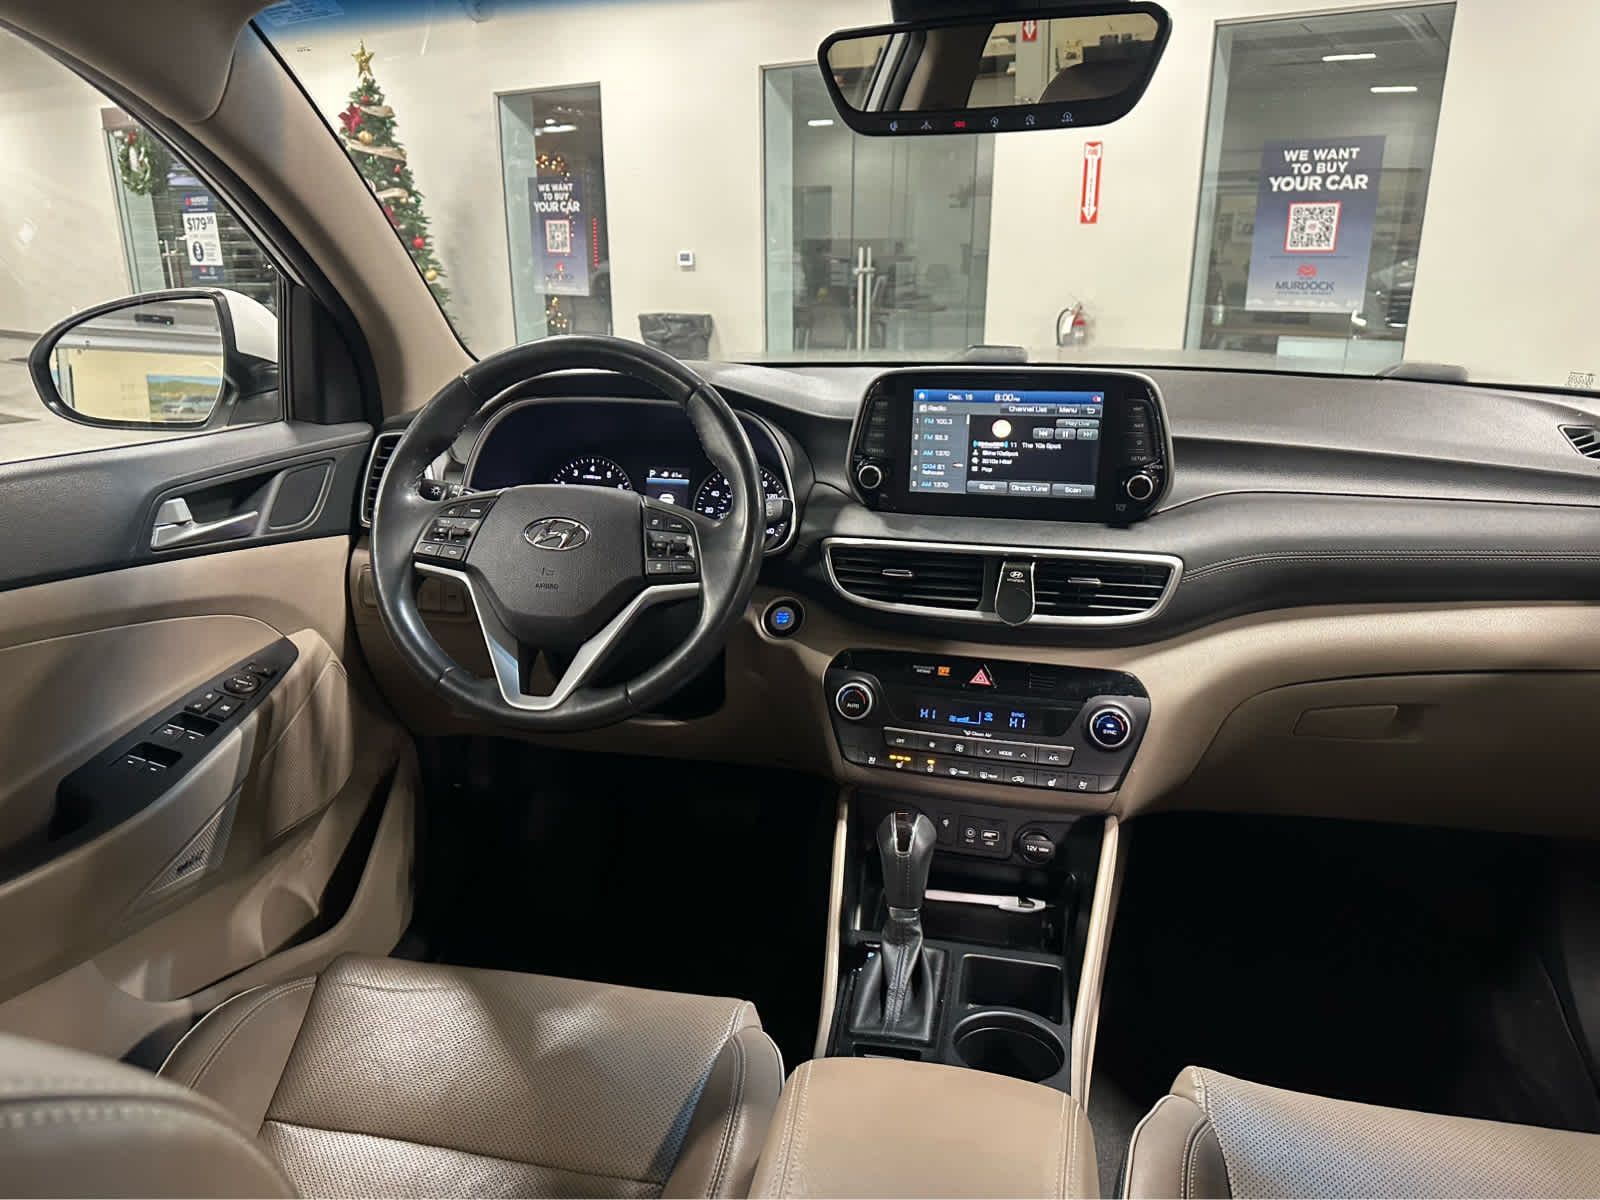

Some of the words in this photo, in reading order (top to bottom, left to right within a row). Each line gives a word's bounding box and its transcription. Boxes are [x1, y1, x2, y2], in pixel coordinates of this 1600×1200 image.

[1283, 149, 1309, 162] WE
[1313, 147, 1360, 161] WANT
[1291, 163, 1312, 174] TO
[1316, 161, 1348, 174] BUY
[538, 183, 551, 192] WE
[551, 183, 573, 192] WANT
[1269, 175, 1322, 192] YOUR
[1325, 174, 1369, 190] CAR
[543, 192, 553, 200] TO
[554, 192, 569, 201] BUY
[533, 201, 559, 213] YOUR
[559, 201, 580, 212] CAR
[186, 217, 207, 231] $179
[1274, 281, 1335, 291] MURDOCK
[1008, 405, 1035, 413] Channel
[589, 465, 596, 473] 4
[1011, 484, 1031, 492] Direct
[1031, 485, 1048, 493] Tune
